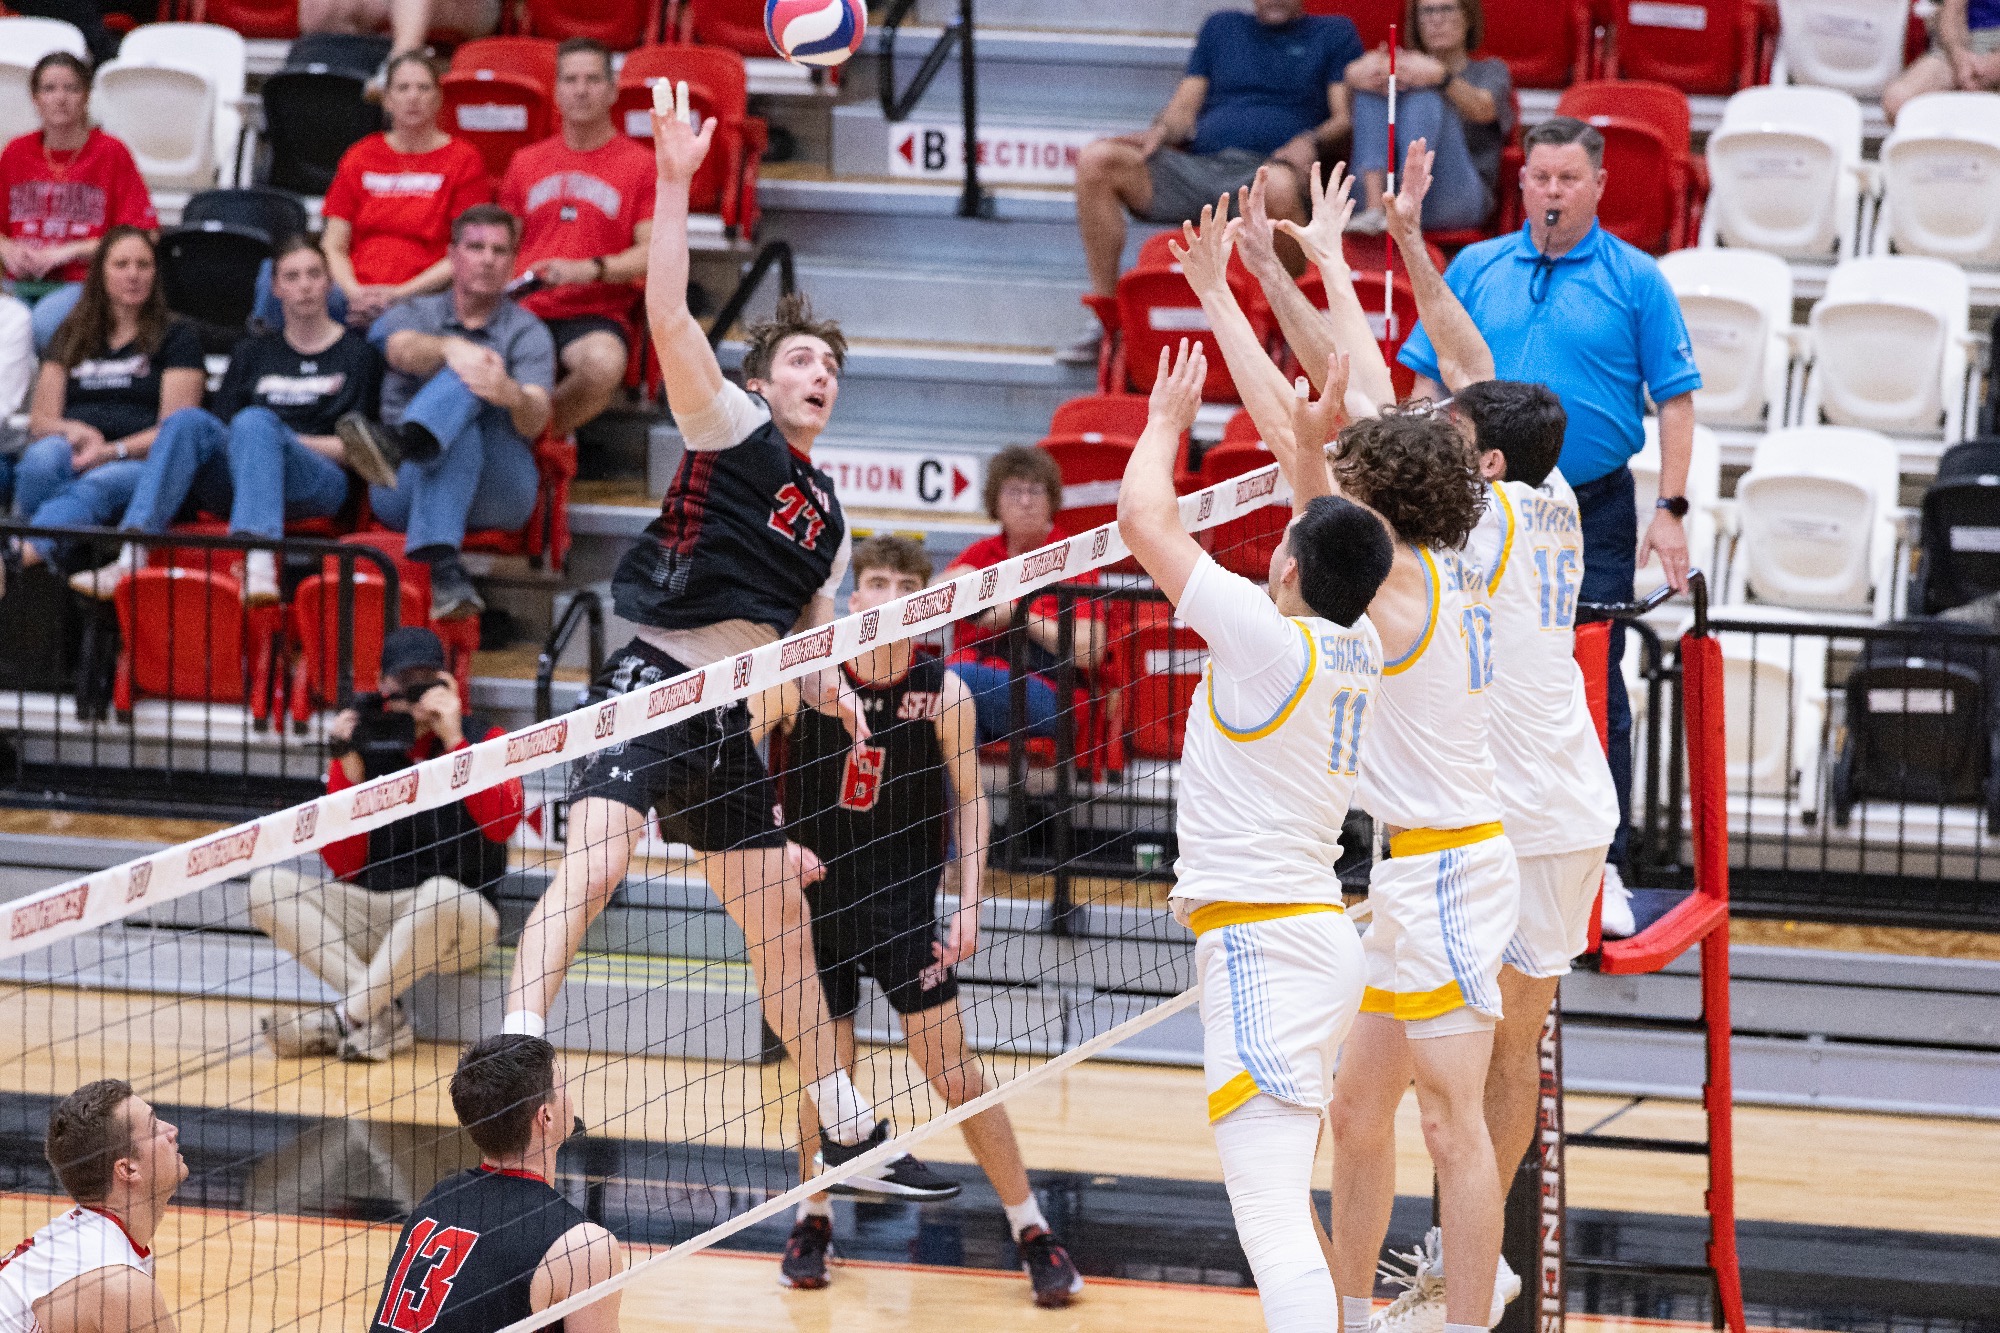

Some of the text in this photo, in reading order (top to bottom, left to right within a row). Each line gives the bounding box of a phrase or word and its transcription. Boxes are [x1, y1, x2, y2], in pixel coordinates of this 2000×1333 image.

[923, 130, 1081, 171] B ECTION
[818, 459, 943, 502] TION C
[1533, 545, 1578, 631] 16
[1460, 602, 1492, 694] 12
[1328, 687, 1369, 776] 11
[839, 747, 886, 812] 6
[378, 1217, 480, 1333] 13
